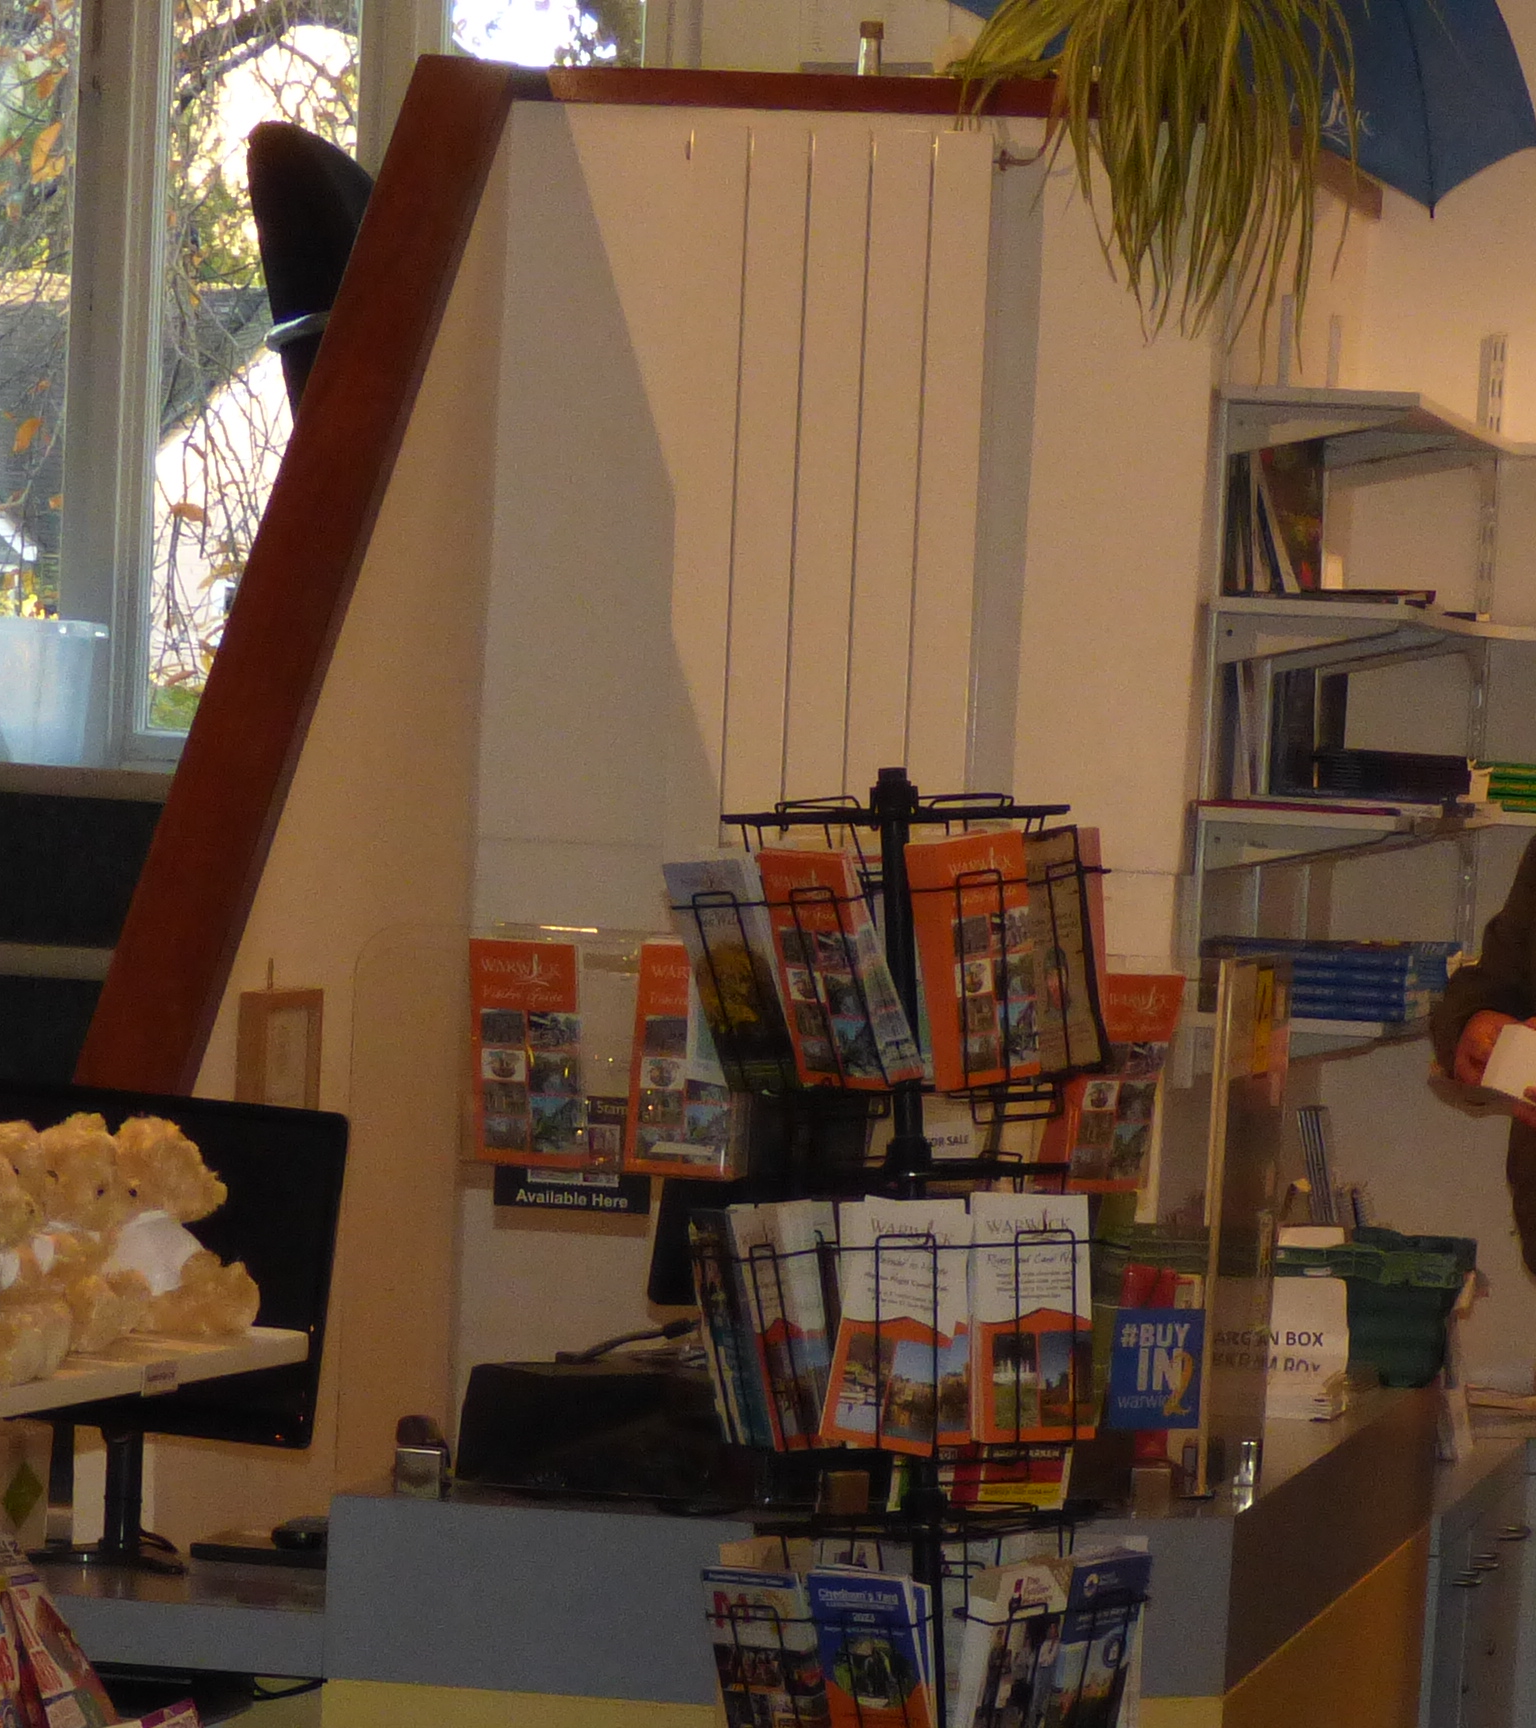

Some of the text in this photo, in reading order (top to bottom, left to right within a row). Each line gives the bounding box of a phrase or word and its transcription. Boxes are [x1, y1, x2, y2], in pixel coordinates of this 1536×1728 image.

[480, 952, 562, 987] WARWICK
[947, 1135, 969, 1147] SALE
[516, 1189, 629, 1210] Available Here
[987, 1207, 1071, 1236] WARWICK
[1120, 1323, 1191, 1349] #BUY
[1285, 1332, 1323, 1346] BOX
[1137, 1347, 1180, 1393] IN
